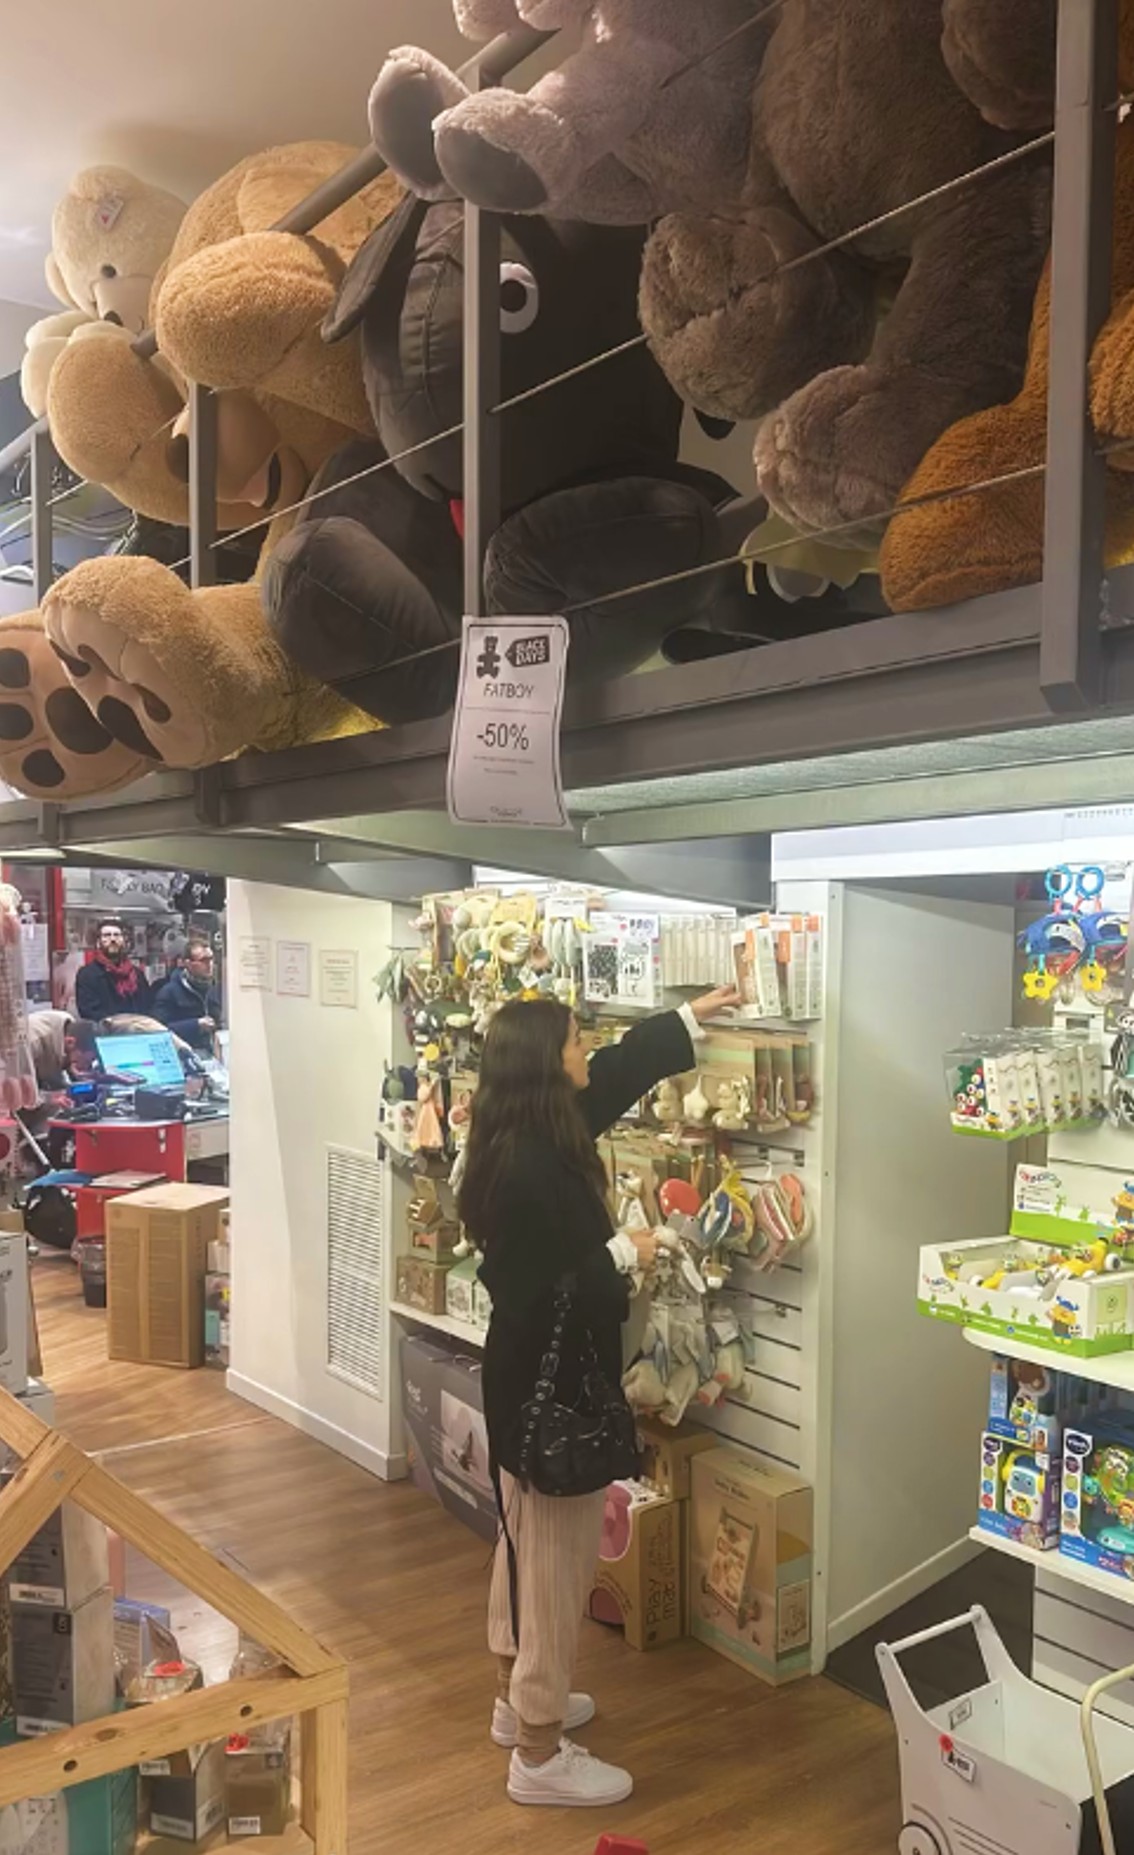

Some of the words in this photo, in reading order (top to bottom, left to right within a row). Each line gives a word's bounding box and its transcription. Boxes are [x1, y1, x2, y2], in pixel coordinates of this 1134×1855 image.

[515, 639, 546, 653] BLACK
[515, 650, 546, 666] DAYS
[483, 682, 534, 699] FATBOY
[476, 723, 530, 750] -50%
[646, 1578, 662, 1626] Play
